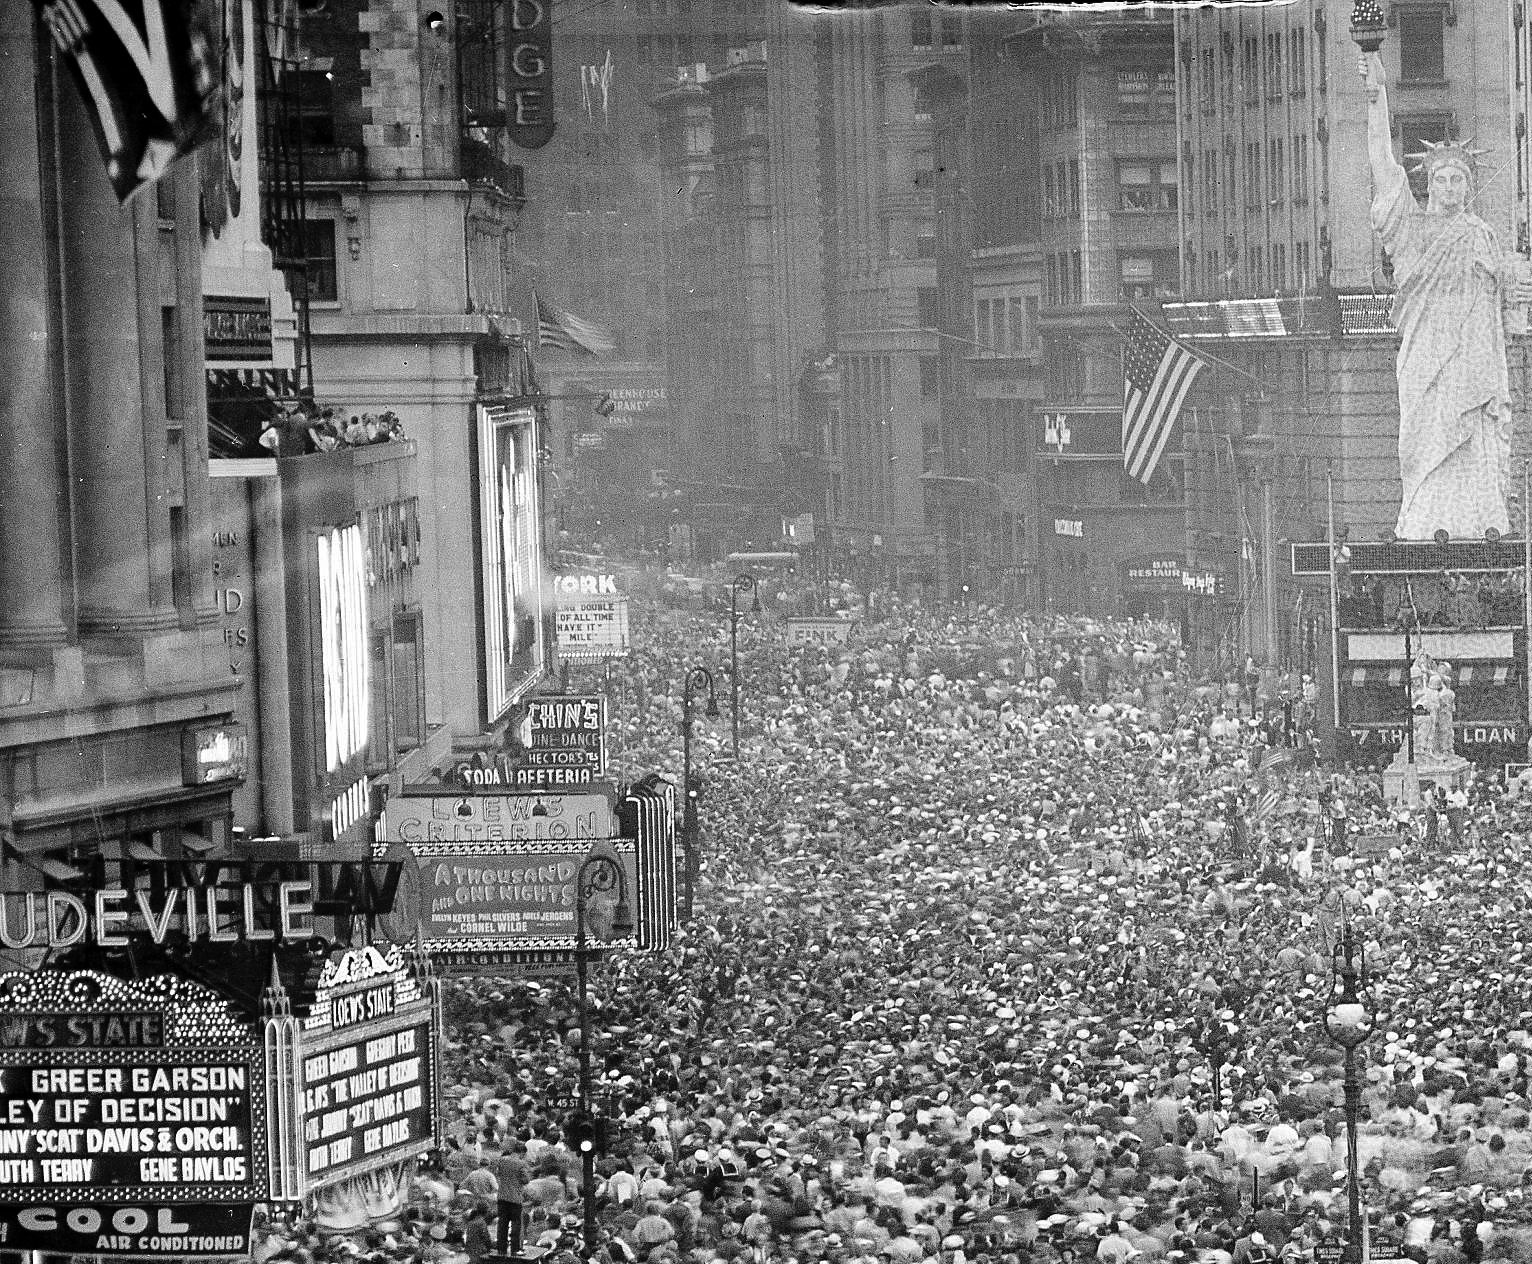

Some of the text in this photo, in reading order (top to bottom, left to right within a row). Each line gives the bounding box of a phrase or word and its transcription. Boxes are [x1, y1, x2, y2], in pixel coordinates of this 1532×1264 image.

[529, 699, 599, 730] CHIN'S
[1463, 728, 1516, 744] LOAN
[517, 768, 590, 784] AFETERIA
[399, 811, 598, 842] CRITERION
[453, 861, 576, 885] THOUSAND
[500, 884, 574, 906] NIGHTS
[460, 921, 496, 933] CORNEL
[498, 921, 528, 933] WILDE
[367, 984, 394, 1019] STATE
[67, 1014, 159, 1046] STATE
[32, 1066, 245, 1094] GREER GARSON
[54, 1099, 90, 1123] OF
[86, 1128, 155, 1153] DAVIS
[175, 1126, 244, 1152] ORCH.
[40, 1159, 93, 1182] TERRY
[140, 1158, 178, 1182] GENE
[181, 1157, 246, 1182] BAYLOS
[17, 1207, 189, 1235] COOL
[96, 1235, 245, 1251] AIR CONDITIONED
